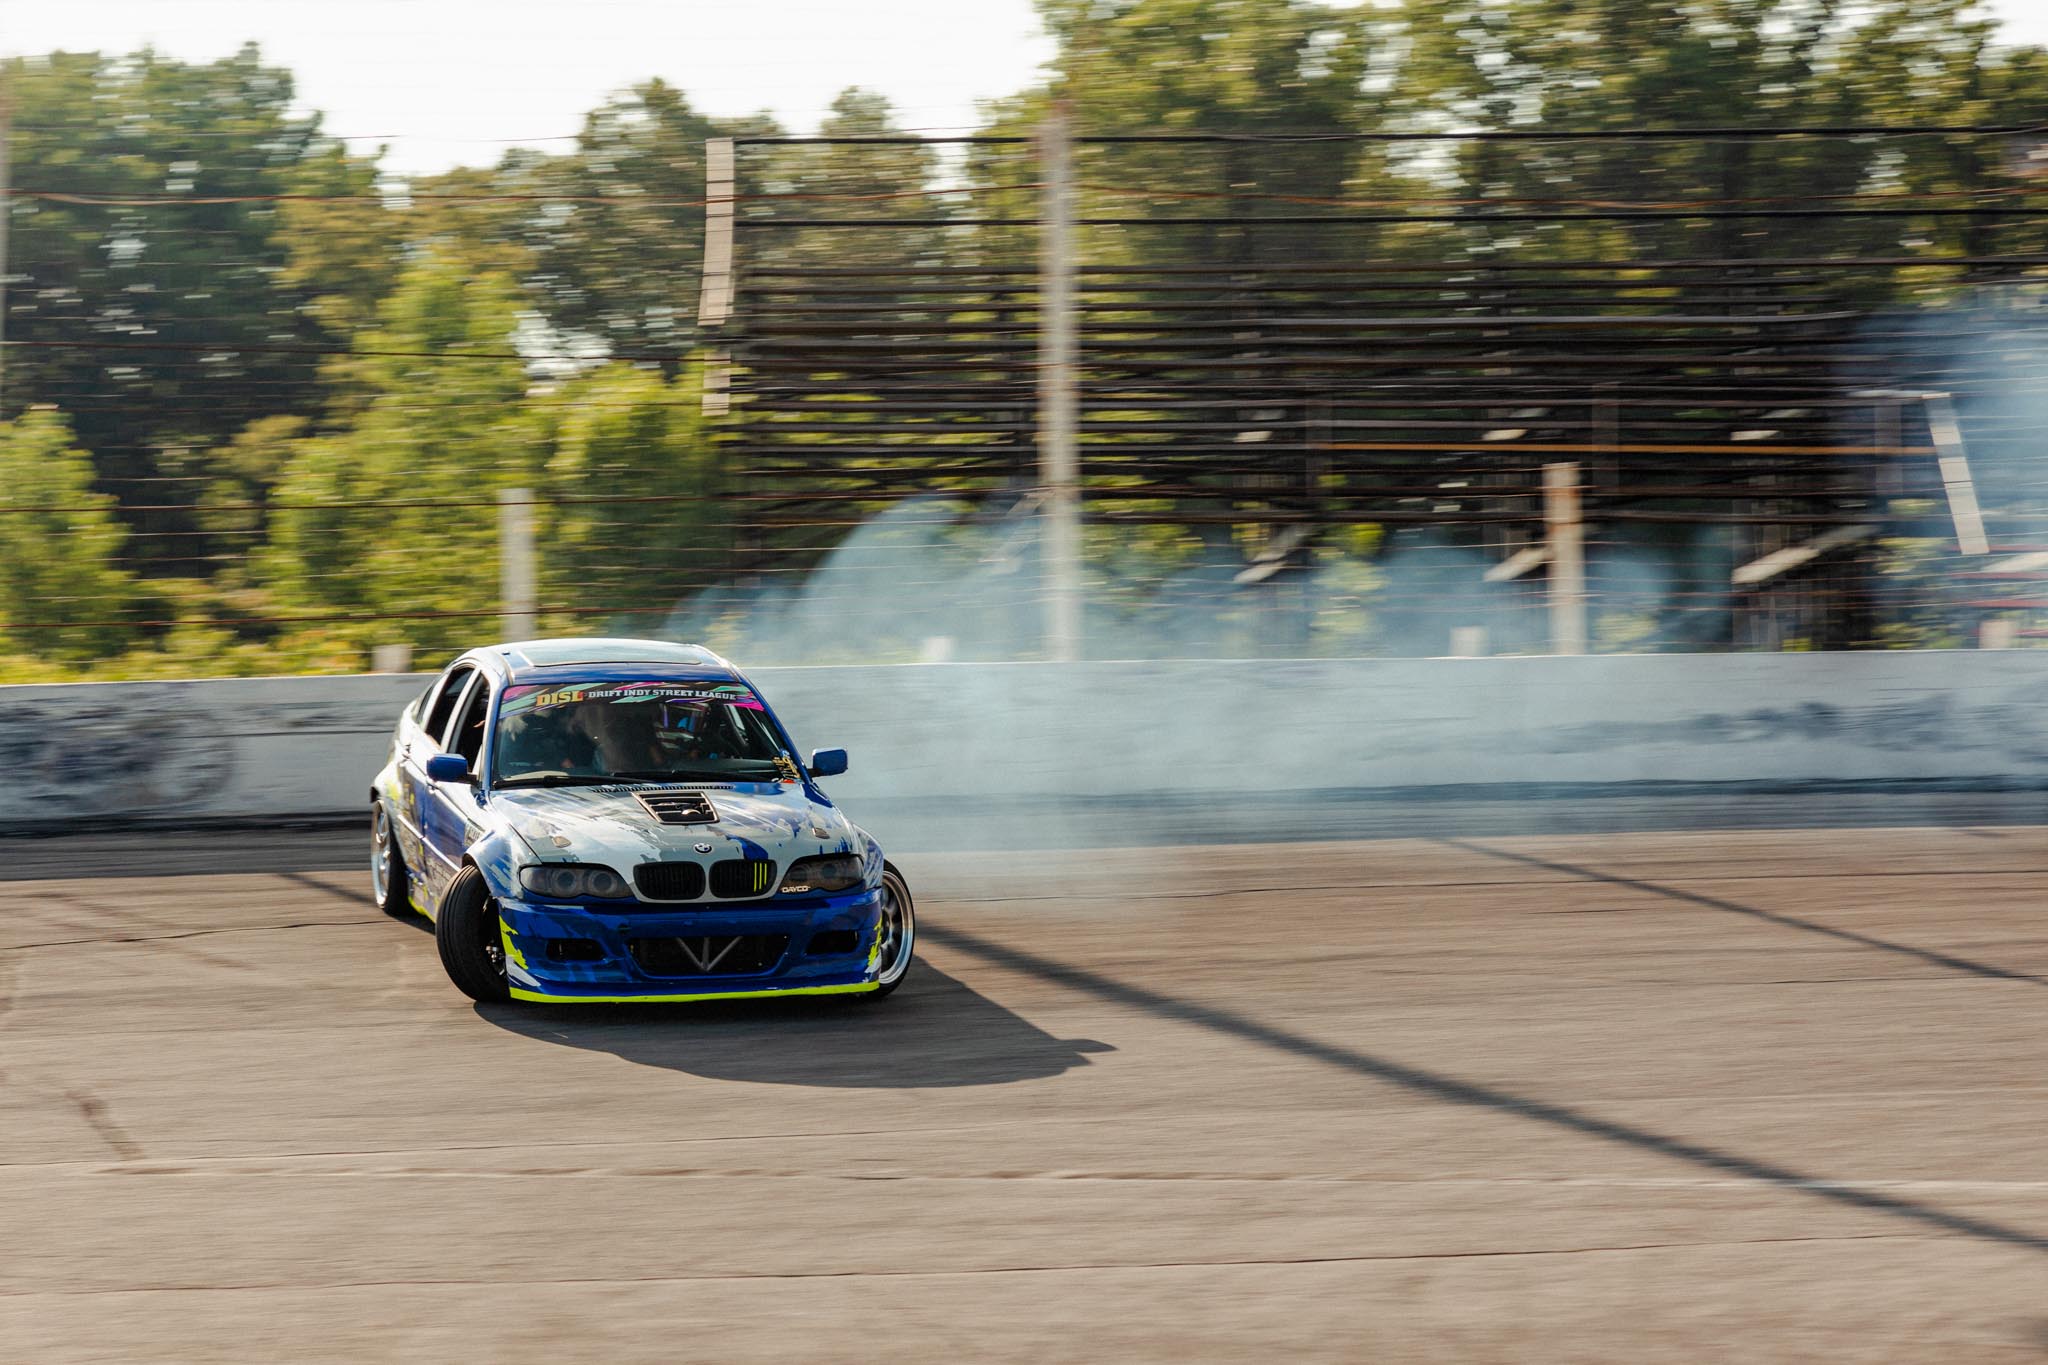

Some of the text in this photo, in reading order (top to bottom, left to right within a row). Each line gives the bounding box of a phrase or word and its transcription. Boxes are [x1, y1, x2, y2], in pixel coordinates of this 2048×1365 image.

[536, 691, 584, 706] DISL
[588, 690, 622, 698] DRIFT
[653, 689, 693, 697] STREET
[695, 690, 737, 700] LEAGUE
